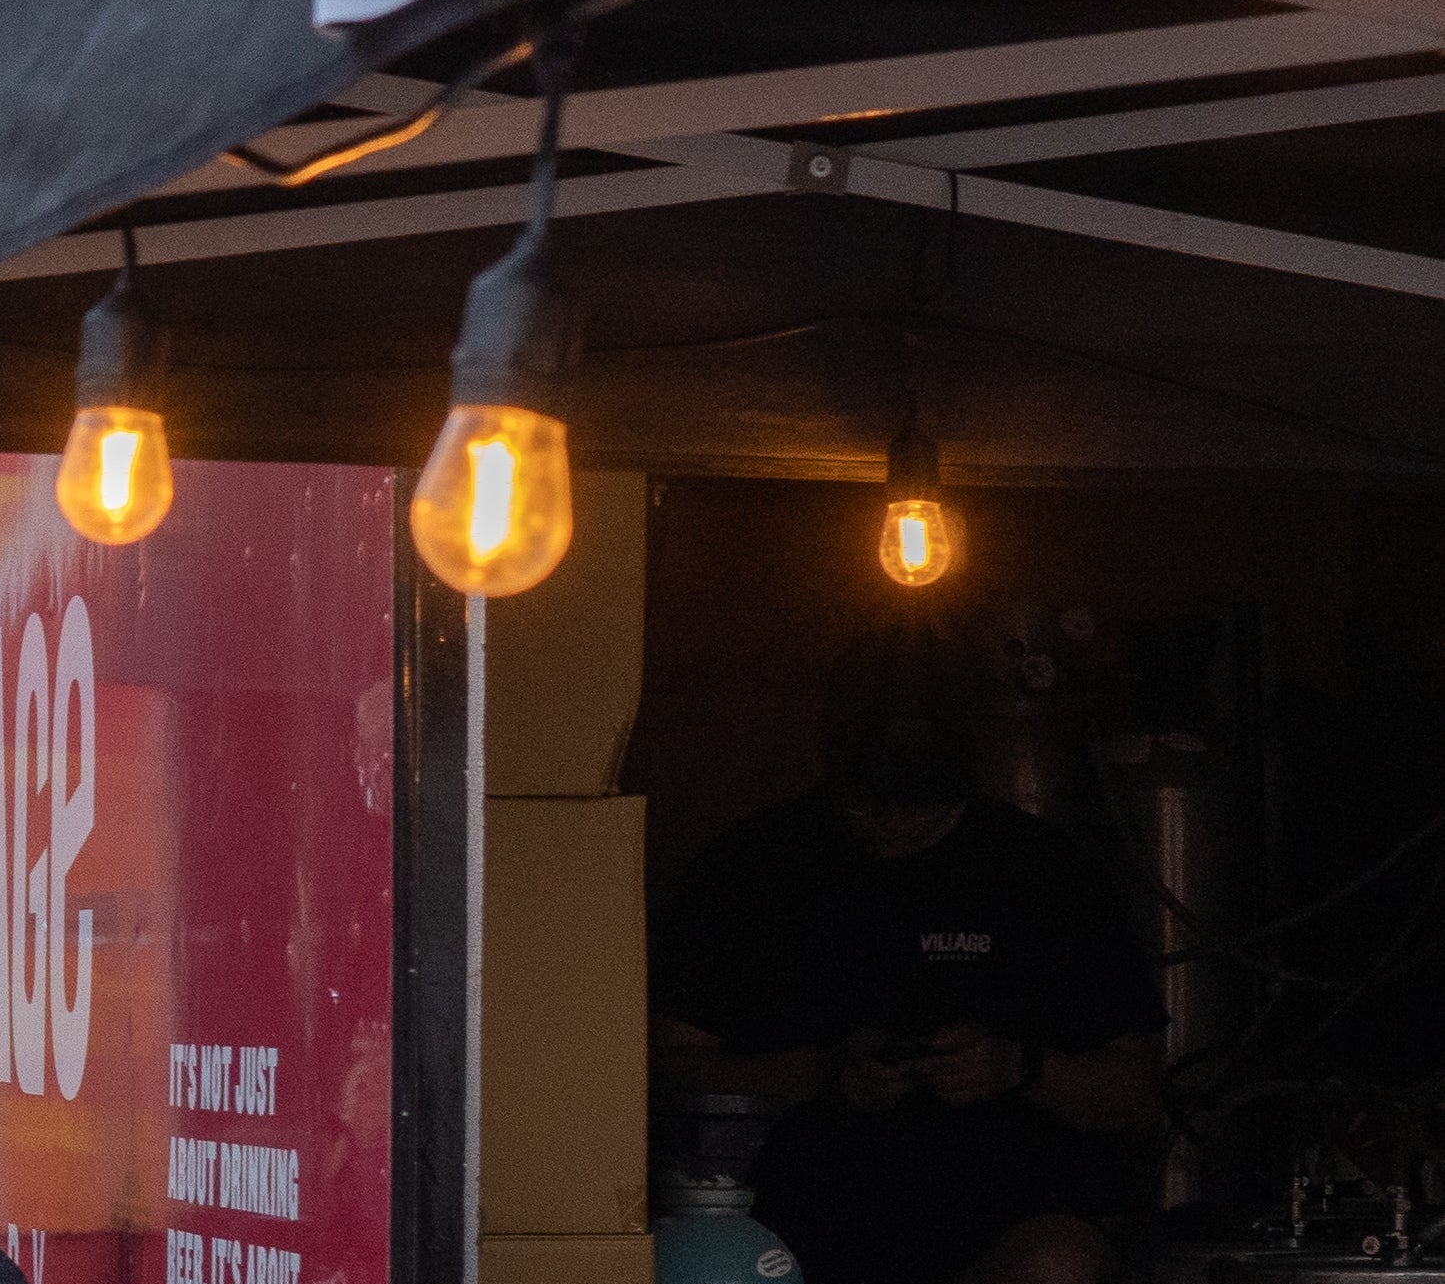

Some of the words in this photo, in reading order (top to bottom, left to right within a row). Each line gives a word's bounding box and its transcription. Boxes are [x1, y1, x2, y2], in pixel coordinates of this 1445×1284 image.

[169, 1044, 197, 1110] IT'S
[200, 1044, 232, 1112] NOT
[235, 1045, 278, 1116] JUST
[167, 1137, 217, 1206] ABOUT
[219, 1142, 299, 1221] DRINKING
